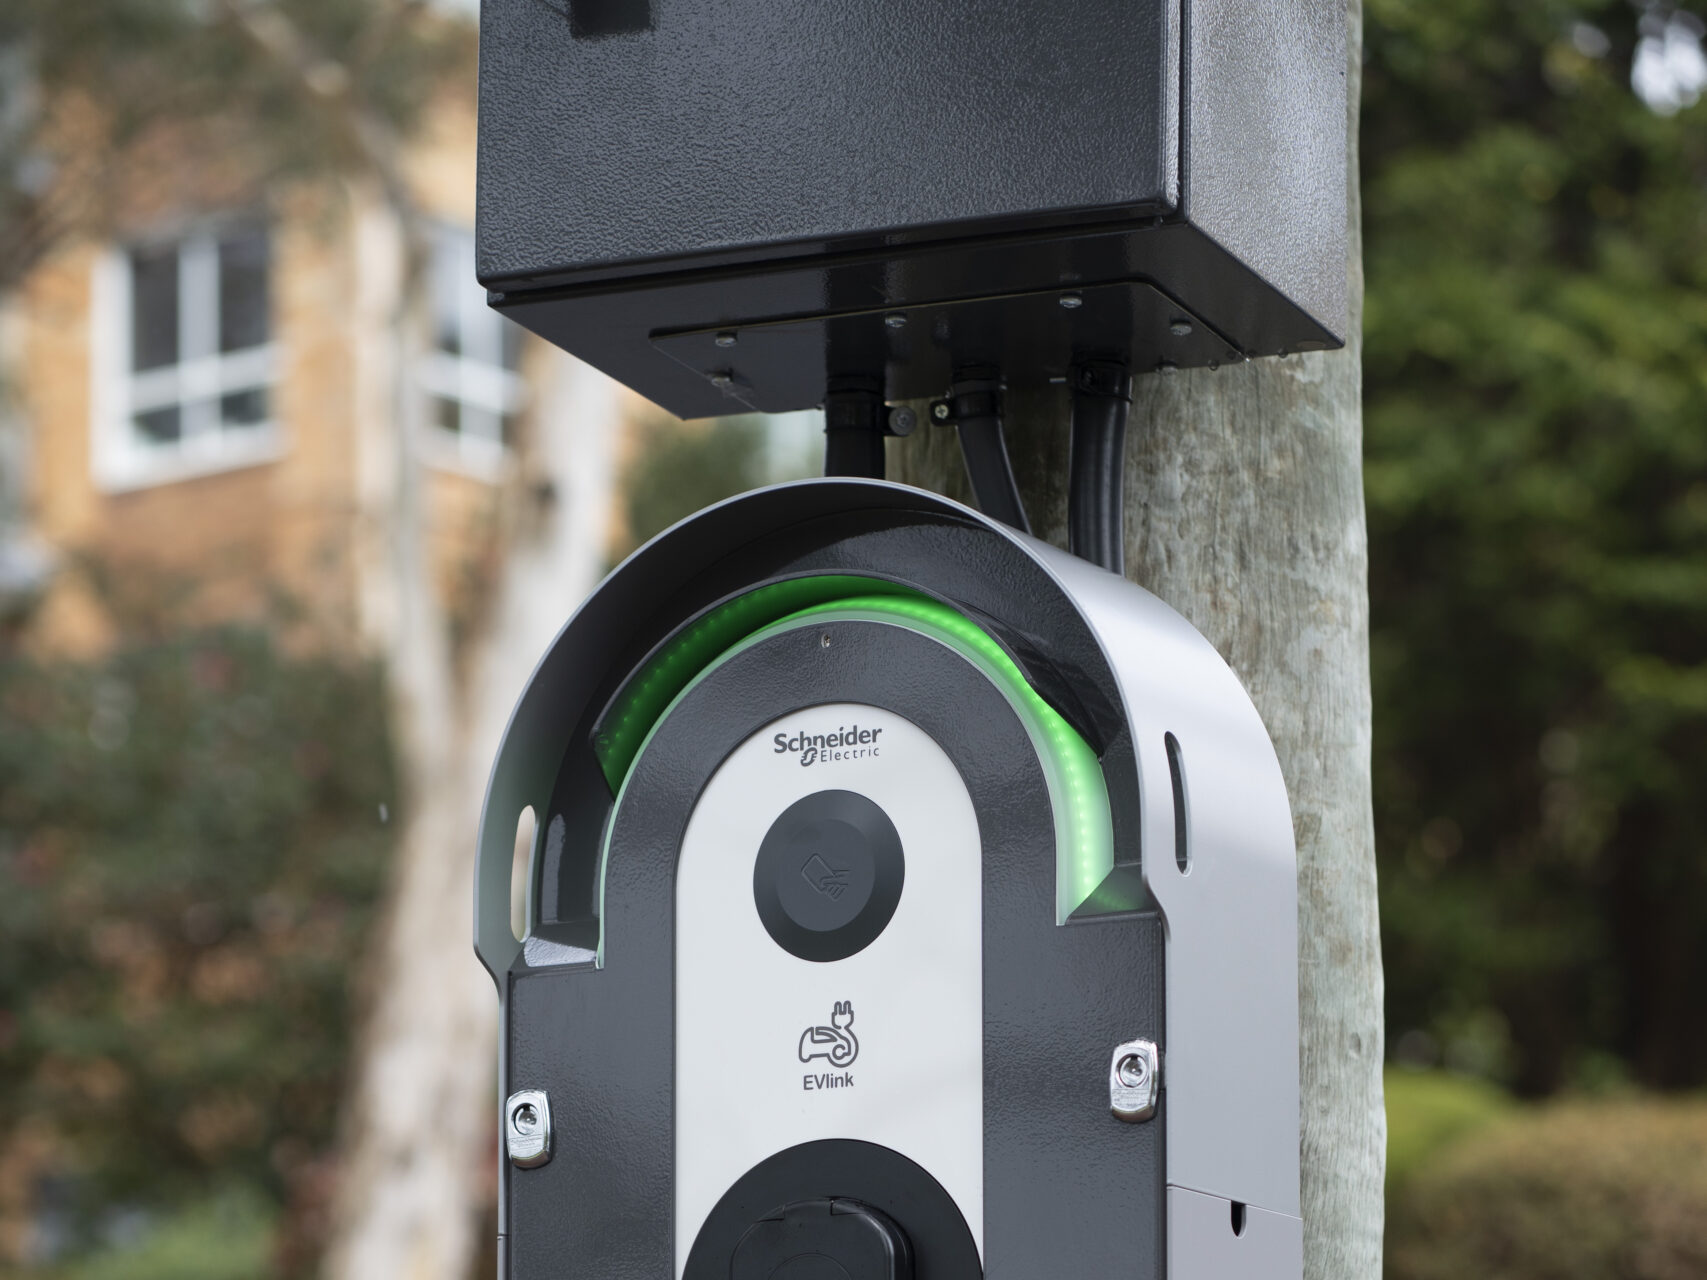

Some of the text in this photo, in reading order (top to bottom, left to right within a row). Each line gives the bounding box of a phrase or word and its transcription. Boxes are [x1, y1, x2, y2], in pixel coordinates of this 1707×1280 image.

[774, 725, 882, 753] Schneider
[821, 746, 880, 762] Electric
[804, 1072, 854, 1090] EVlink
